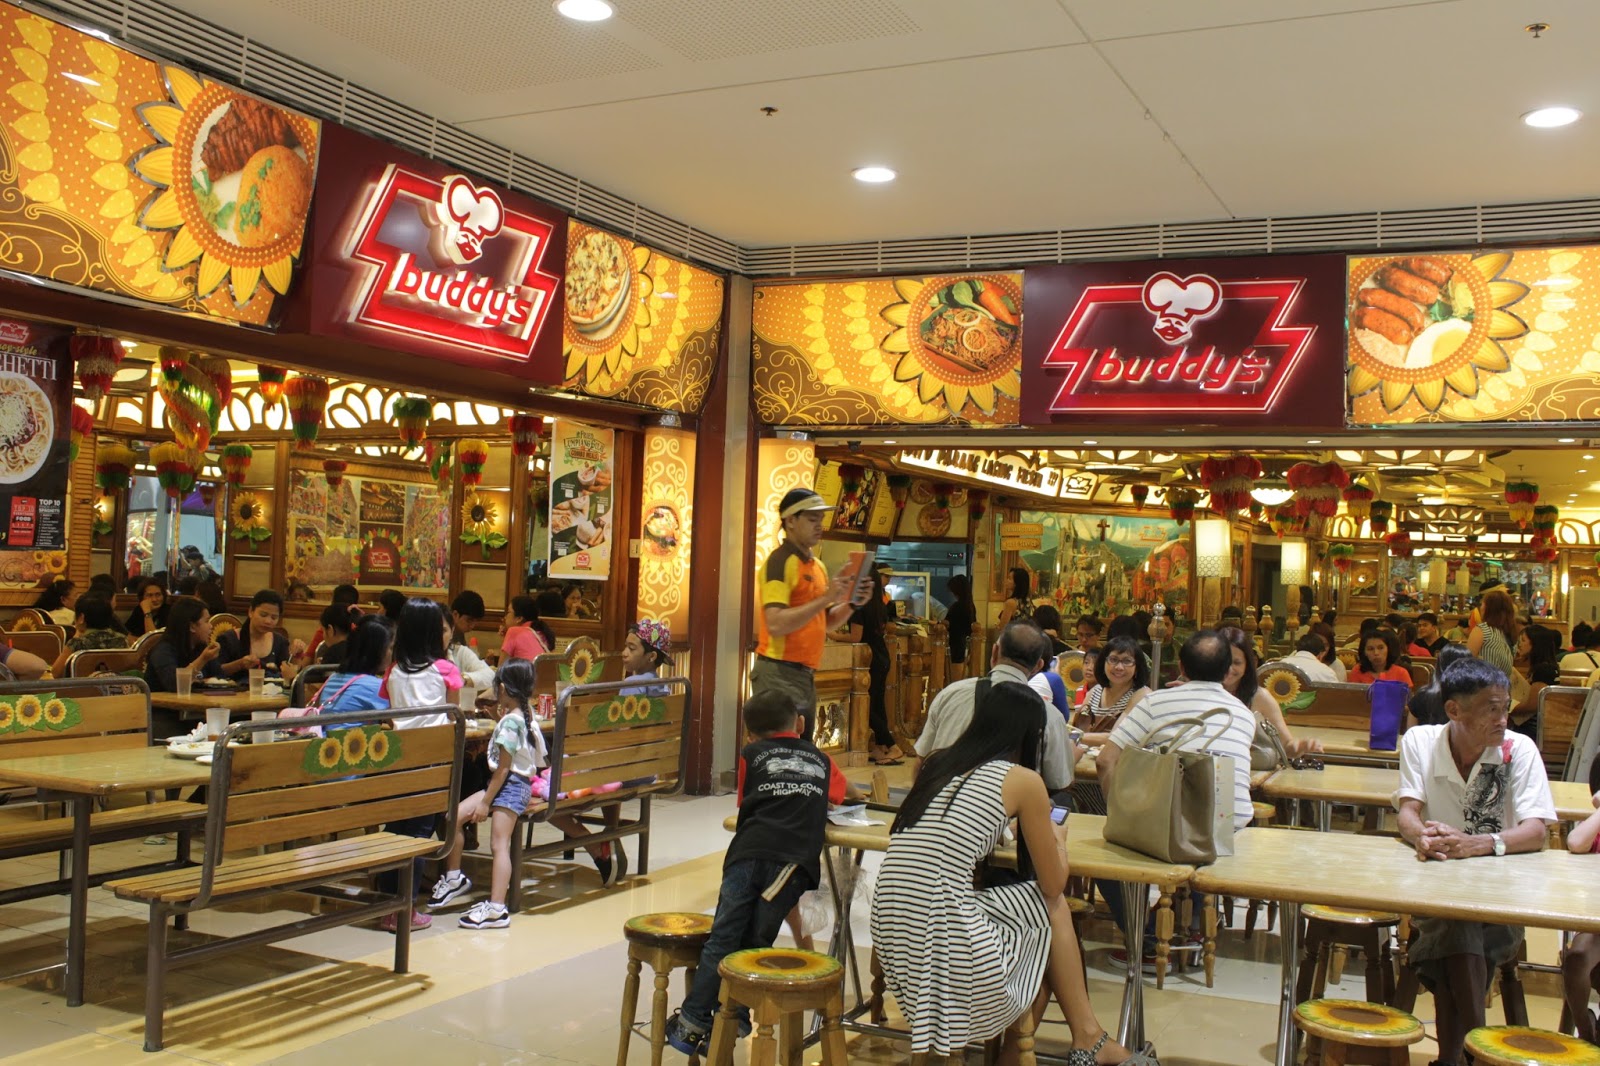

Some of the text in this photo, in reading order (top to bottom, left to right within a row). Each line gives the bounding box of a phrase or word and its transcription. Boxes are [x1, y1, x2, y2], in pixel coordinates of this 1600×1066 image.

[390, 253, 533, 327] buddy's
[1091, 345, 1270, 391] buddy's
[757, 782, 785, 792] COAST
[800, 782, 823, 796] COAST
[773, 787, 812, 796] HIGHWAY
